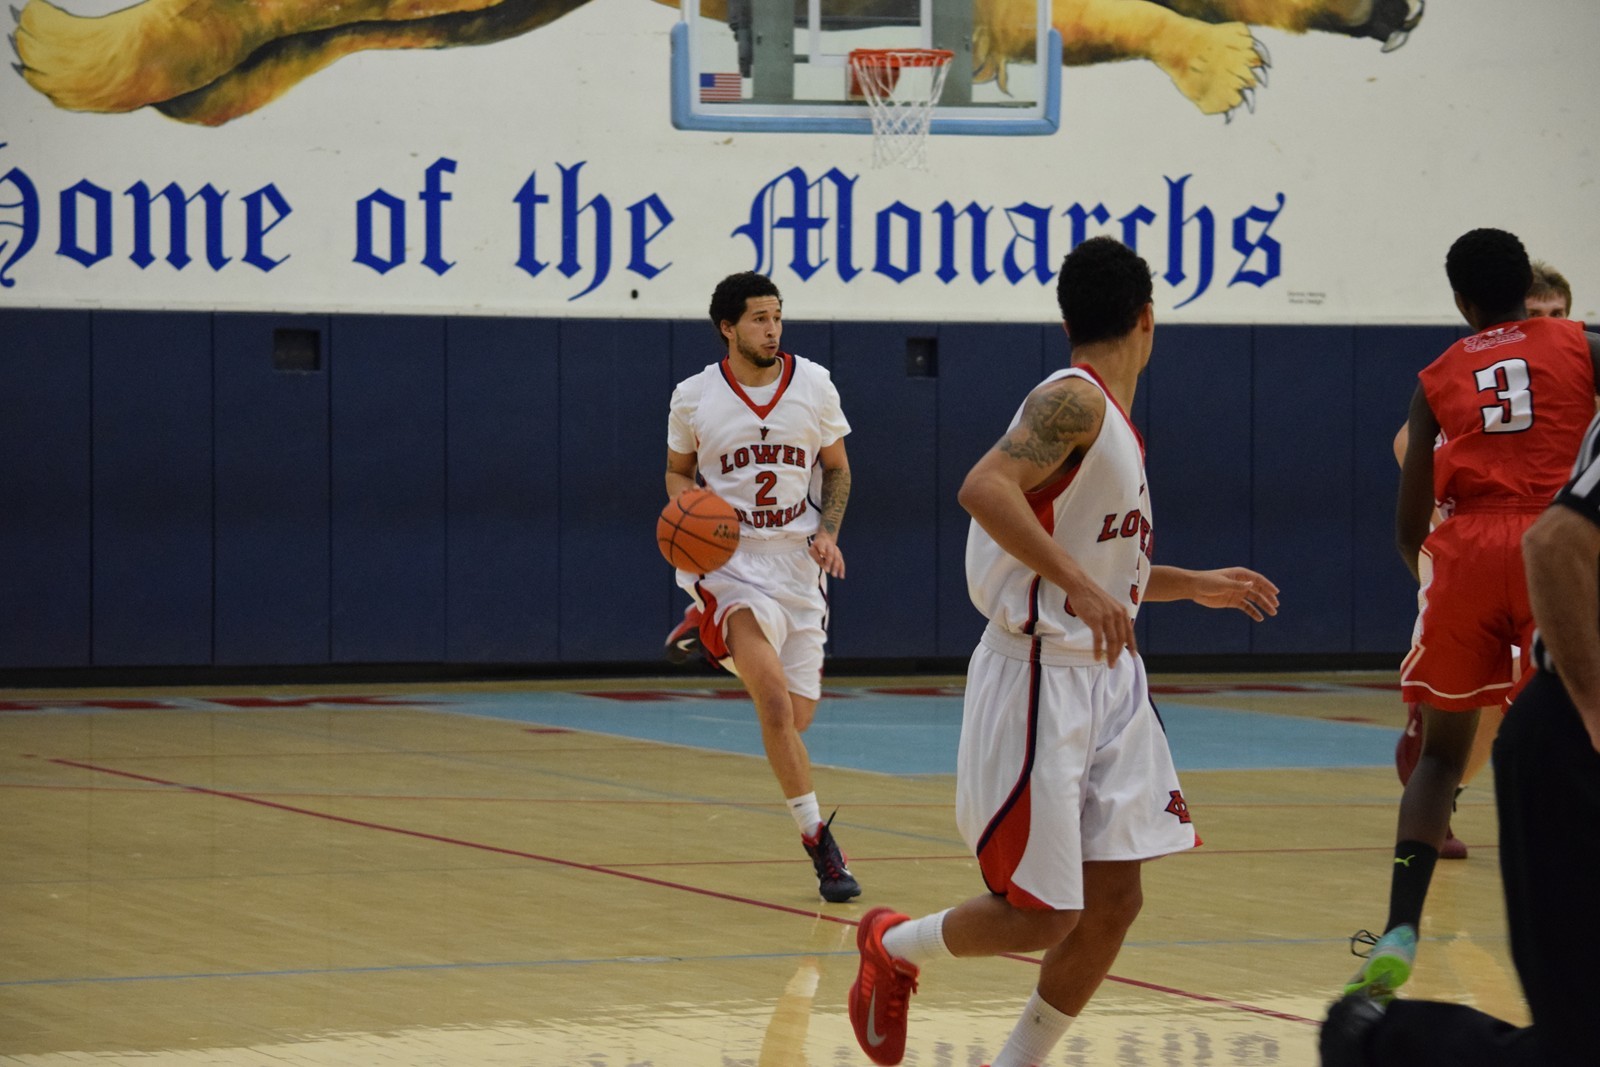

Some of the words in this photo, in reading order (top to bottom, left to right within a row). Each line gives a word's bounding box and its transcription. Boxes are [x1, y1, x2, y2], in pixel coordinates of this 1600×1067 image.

[351, 156, 458, 277] of
[512, 160, 675, 302] the
[730, 165, 1286, 310] Monarchs
[1473, 357, 1534, 435] 3
[719, 444, 807, 475] LOWER
[755, 470, 777, 507] 2
